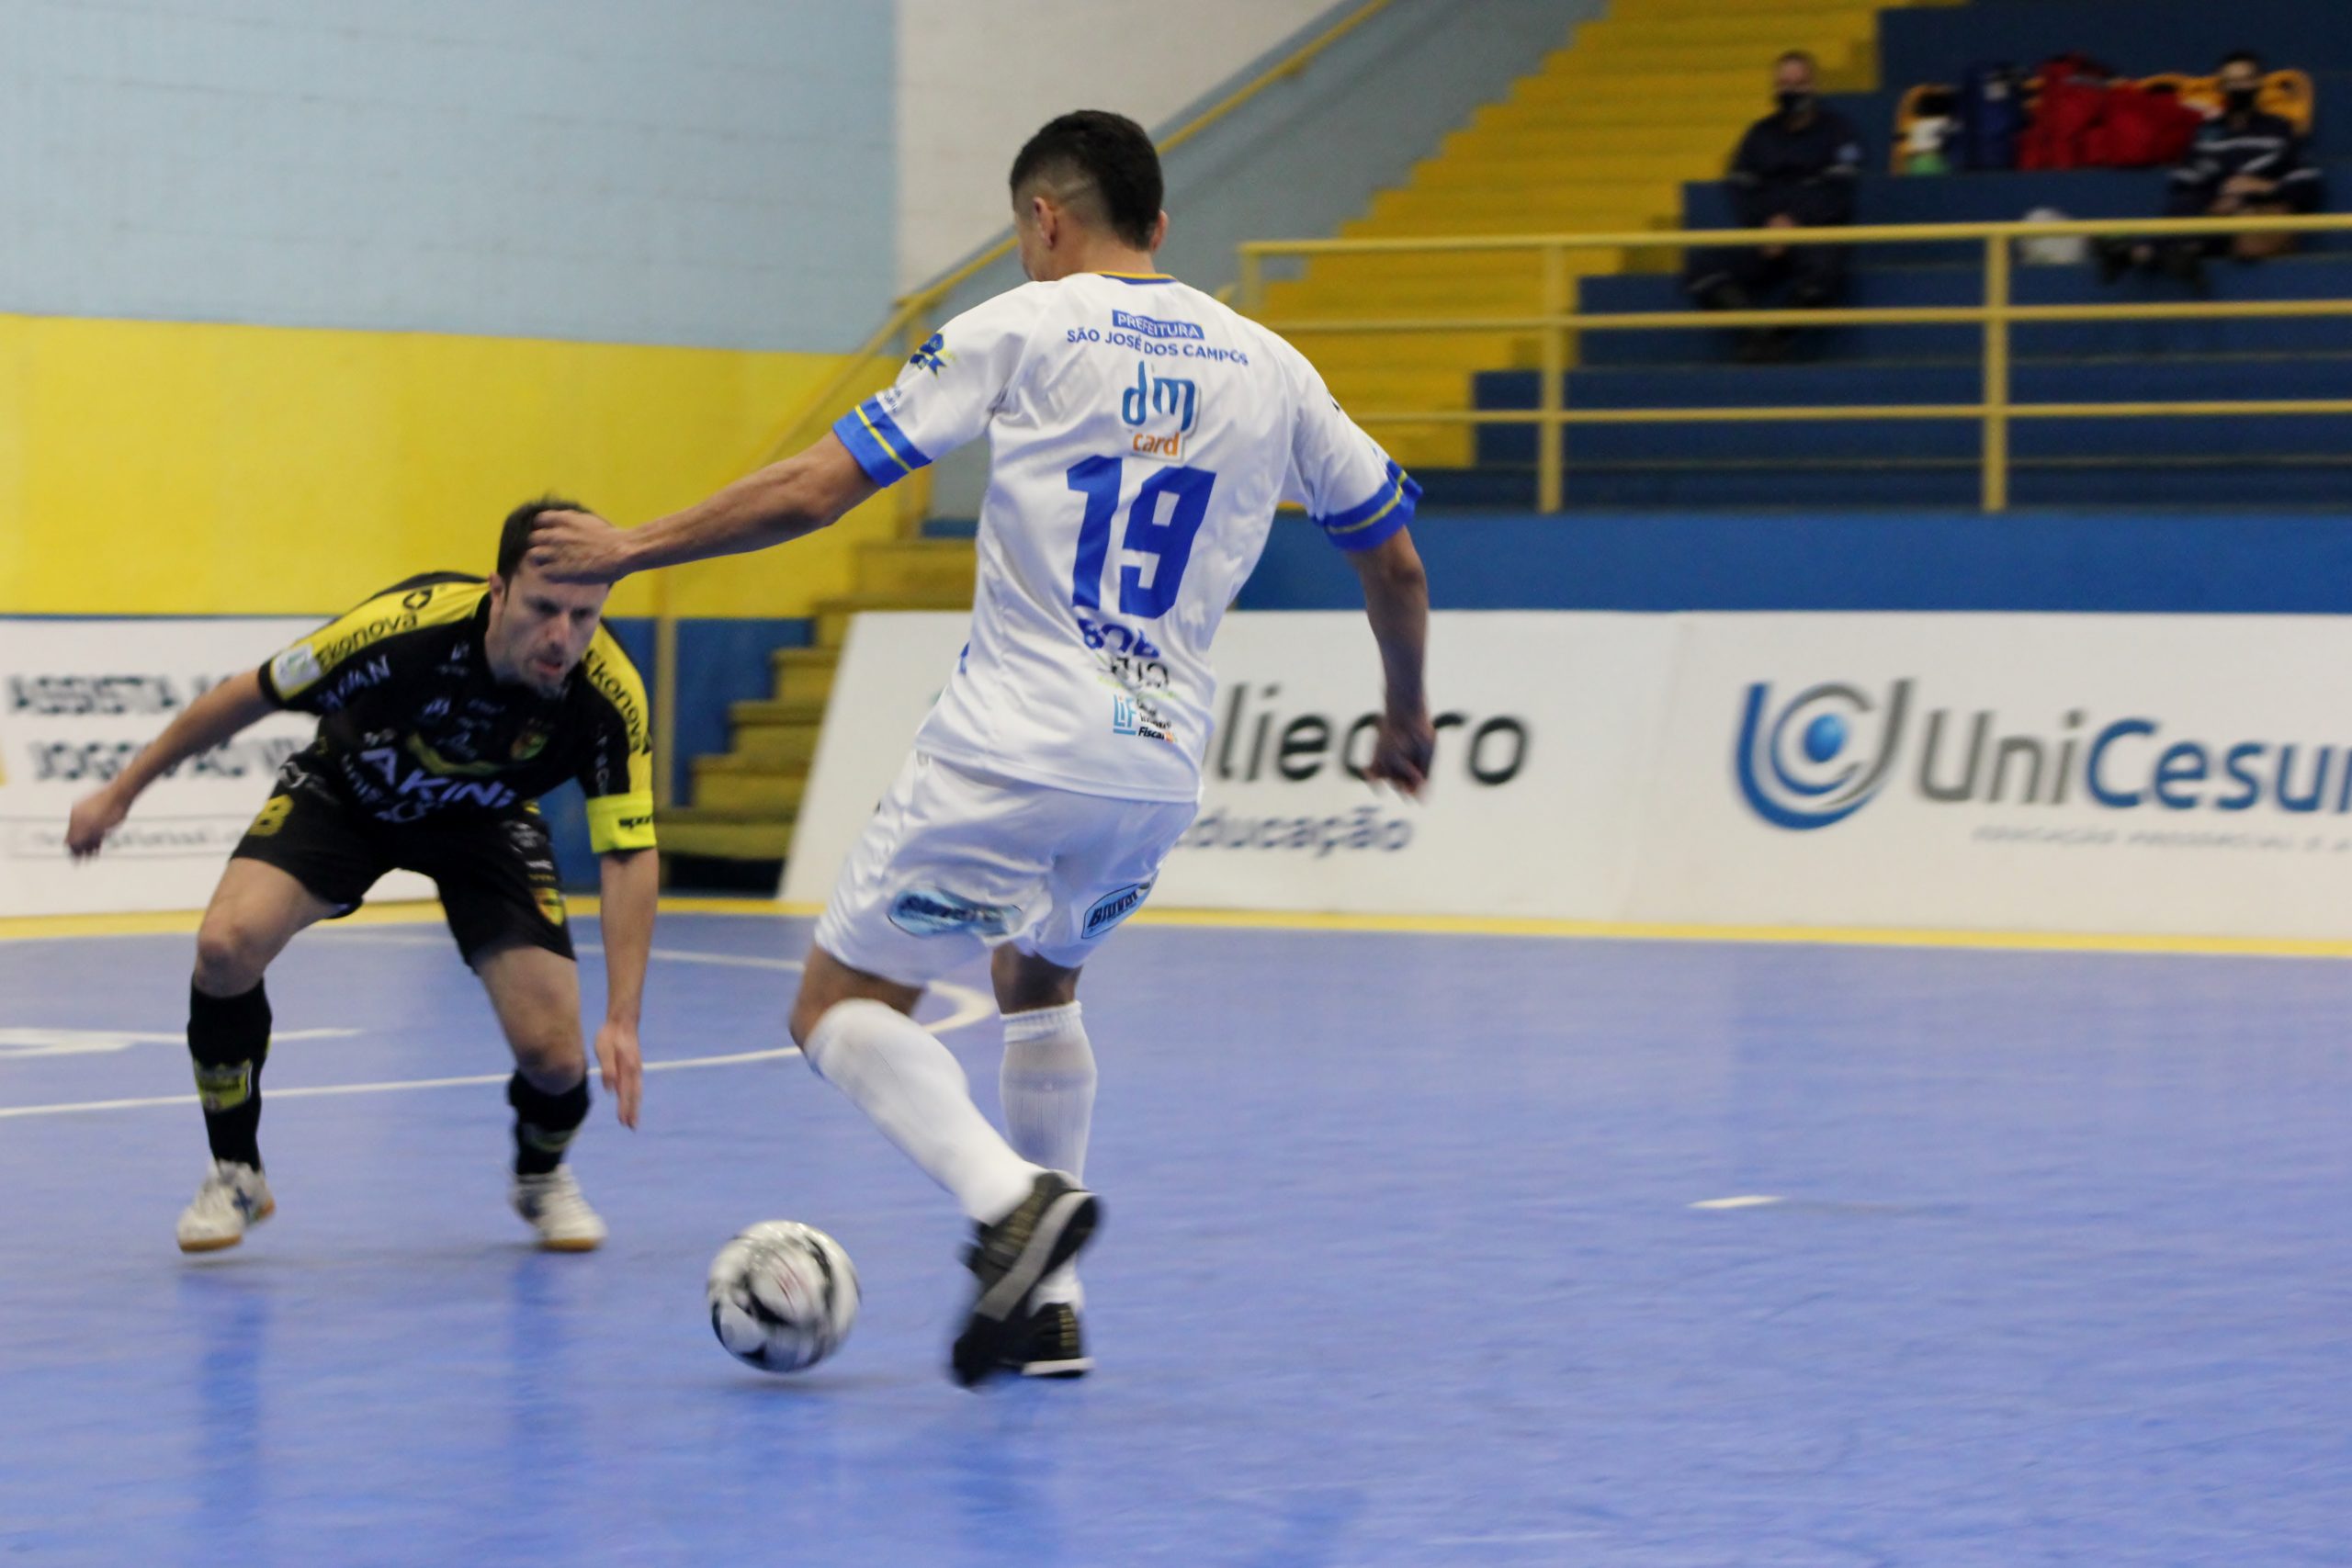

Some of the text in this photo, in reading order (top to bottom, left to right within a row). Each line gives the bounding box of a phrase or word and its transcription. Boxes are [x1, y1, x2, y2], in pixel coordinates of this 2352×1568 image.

[1067, 327, 1249, 366] SÃO JOSÉ DOS CAMPOS
[1117, 312, 1200, 339] PREFEITURA
[1122, 360, 1196, 432] dm
[1133, 432, 1180, 457] card
[1067, 455, 1217, 619] 19
[1176, 805, 1415, 859] ducação
